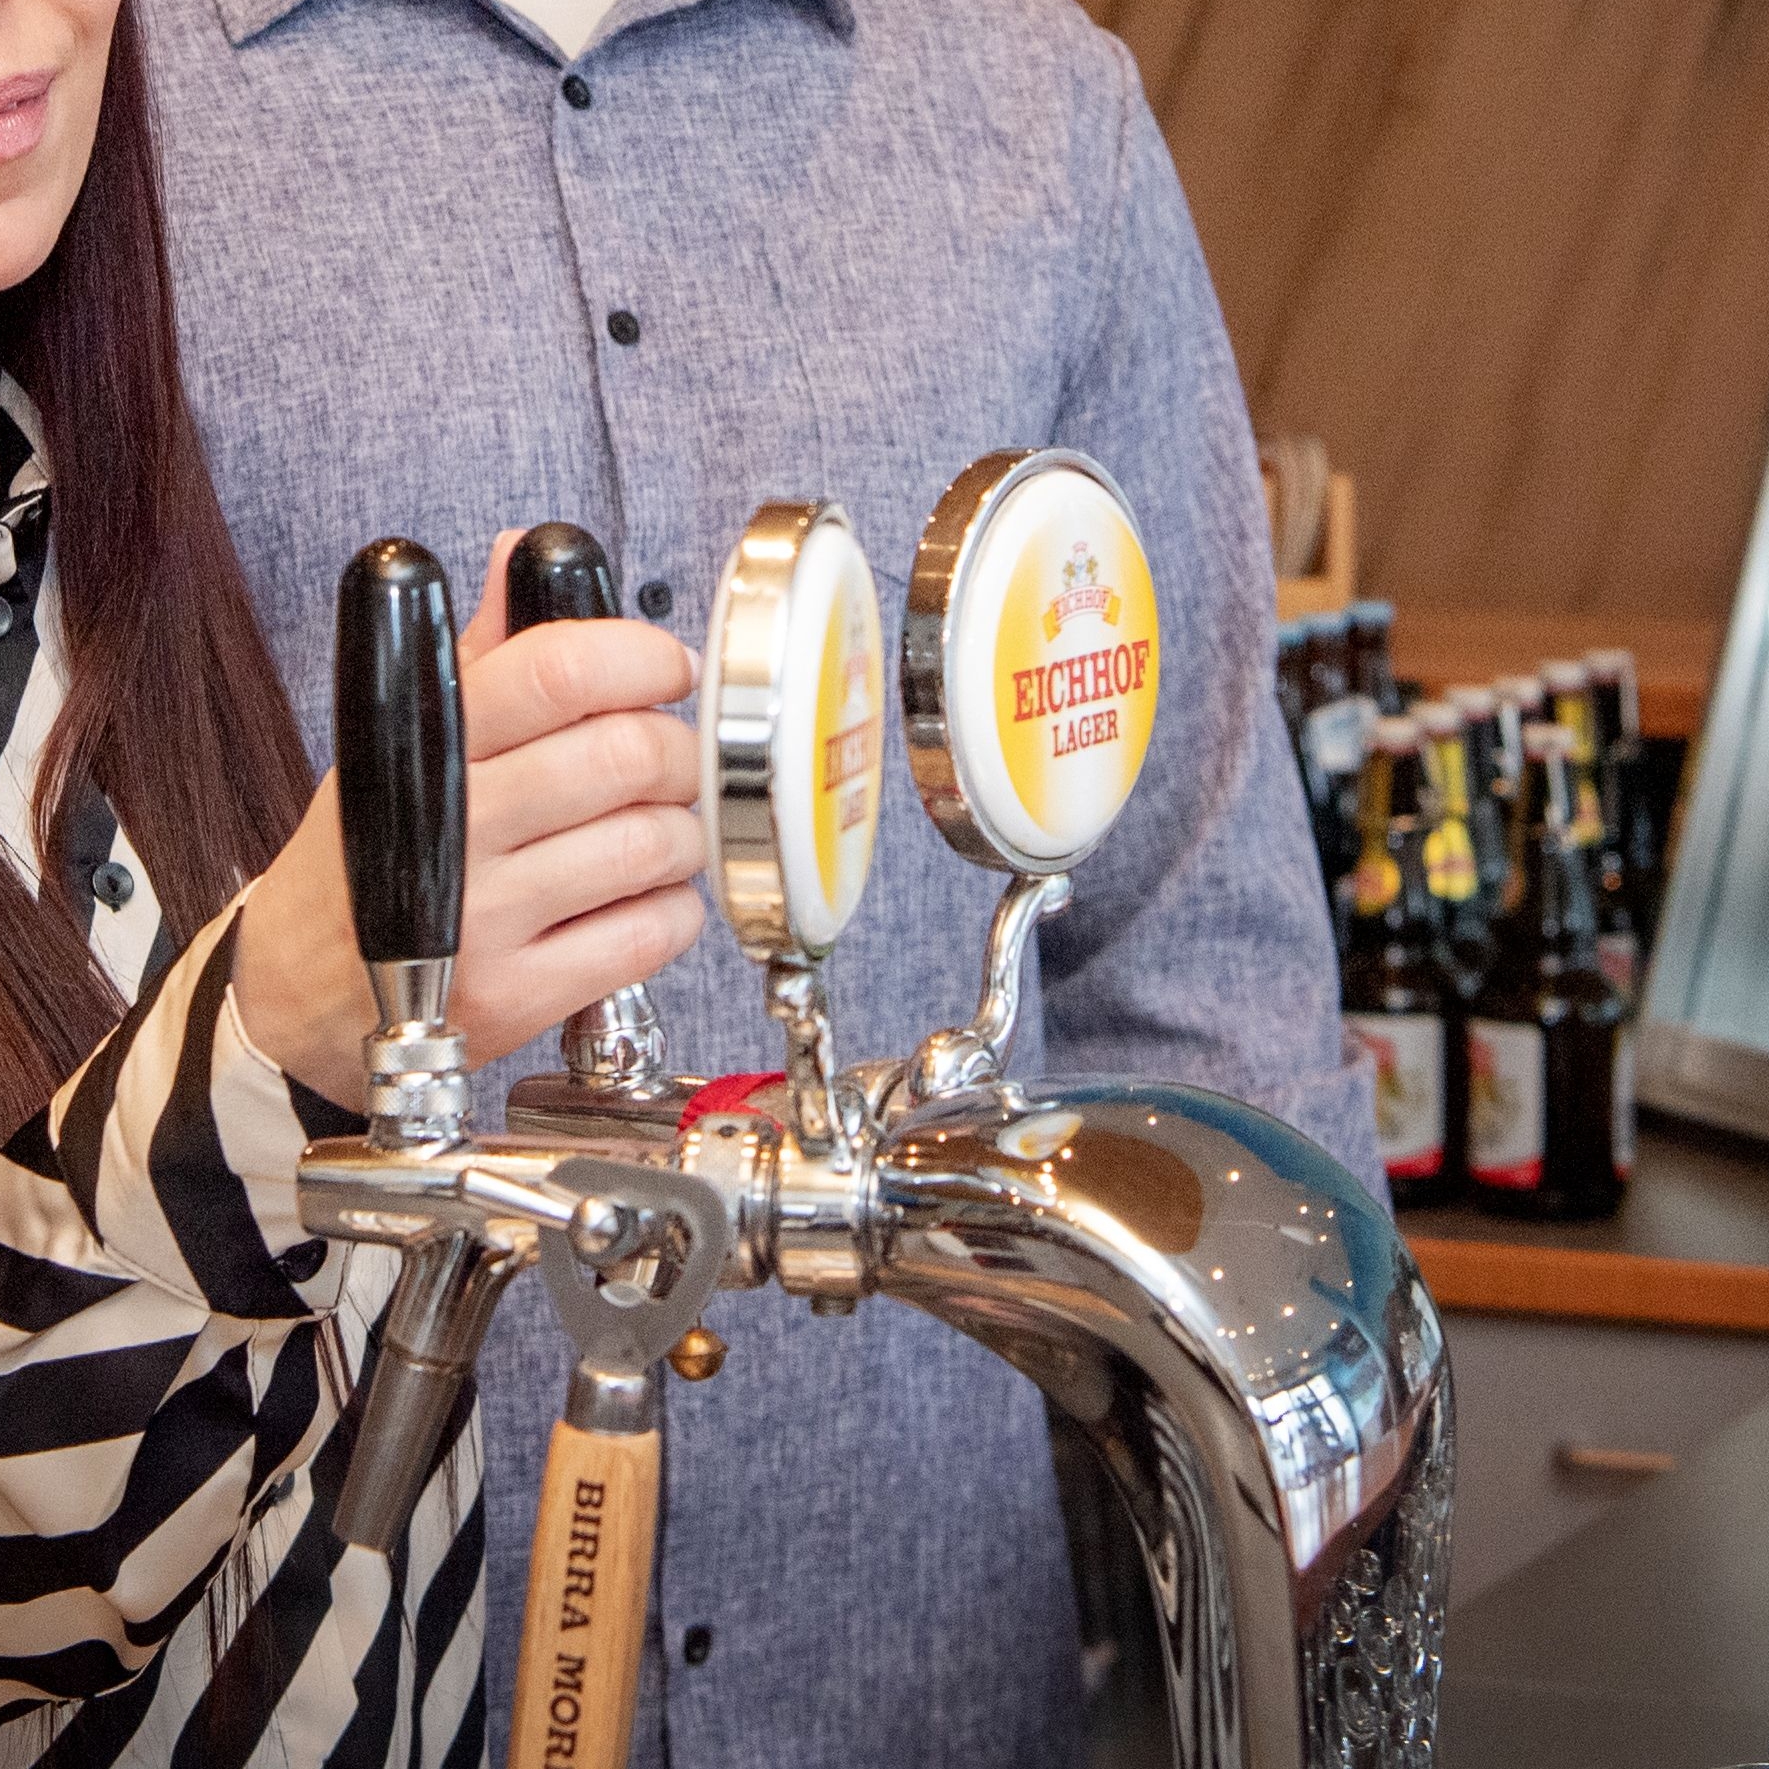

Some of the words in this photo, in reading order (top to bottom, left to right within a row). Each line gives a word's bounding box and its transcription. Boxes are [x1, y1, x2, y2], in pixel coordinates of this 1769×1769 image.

[1012, 639, 1150, 723] EICHHOF
[1051, 709, 1119, 758] LAGER
[560, 1479, 605, 1632] BIRRA
[543, 1652, 586, 1769] MOR
